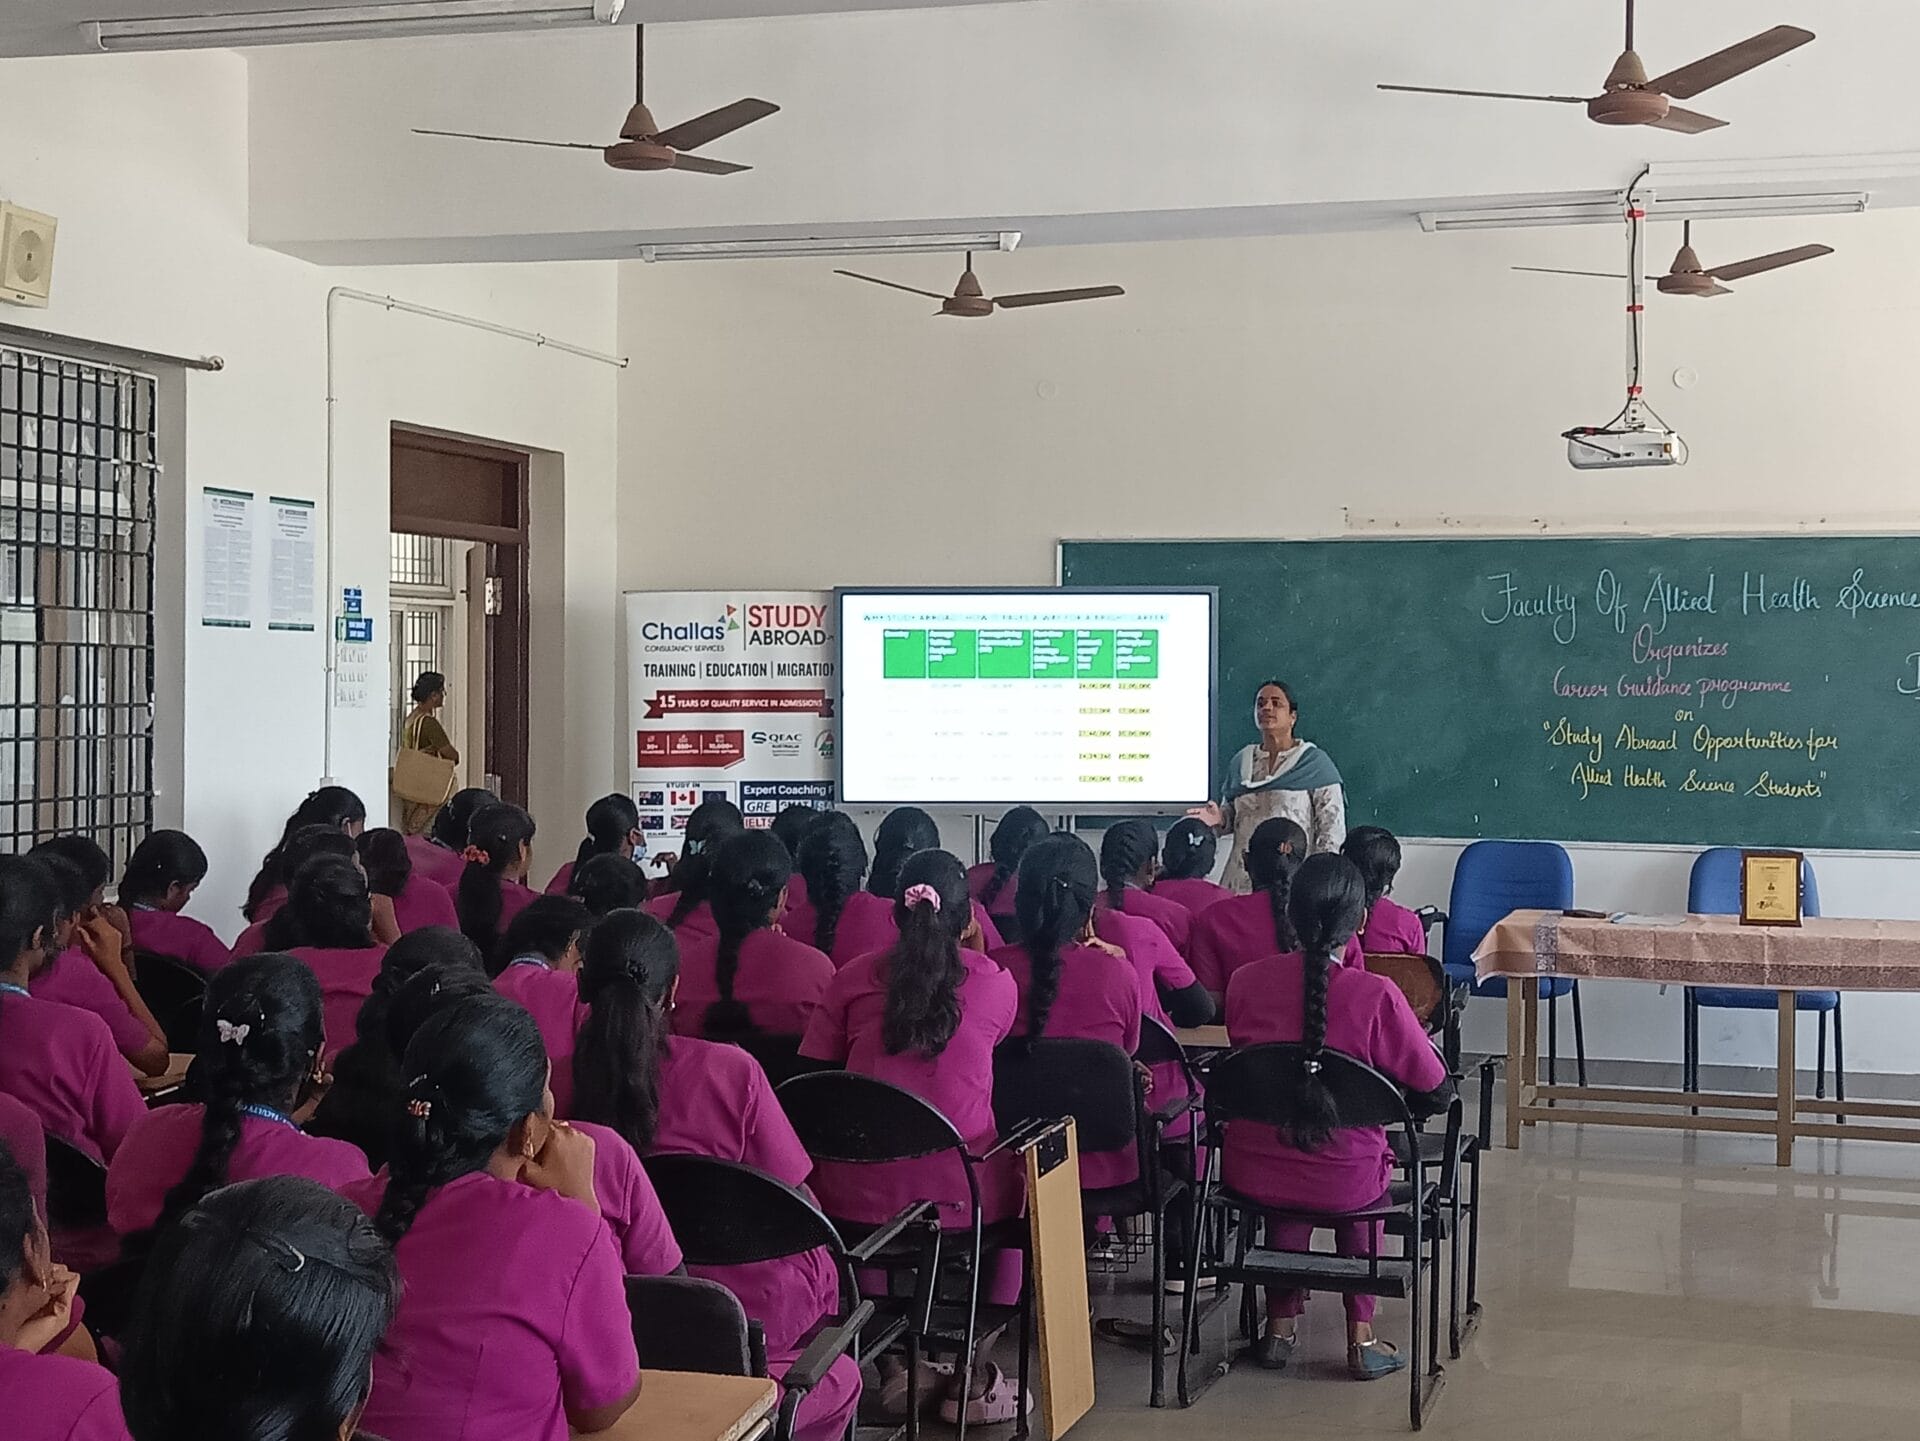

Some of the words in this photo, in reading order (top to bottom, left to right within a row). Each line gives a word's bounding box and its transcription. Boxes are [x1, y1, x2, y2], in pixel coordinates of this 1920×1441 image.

[1481, 572, 1576, 644] Faculty
[1596, 568, 1628, 633] Of
[1643, 572, 1717, 635] Allied
[1743, 571, 1821, 616] Health
[748, 605, 827, 627] STUDY
[642, 622, 725, 640] Challas
[748, 630, 826, 646] ABROAD
[644, 644, 692, 652] CONSULTANCY
[694, 644, 725, 652] SERVICES
[1632, 623, 1729, 679] Organizes
[643, 663, 696, 677] TRAINING
[706, 663, 767, 677] EDUCATION
[1553, 665, 1608, 698] Career
[1617, 674, 1692, 697] Guidance
[1696, 677, 1792, 710] programme
[659, 695, 676, 708] 15
[677, 699, 699, 708] YEARS
[700, 699, 709, 708] OF
[710, 699, 740, 708] QUALITY
[741, 699, 769, 708] SERVICE
[770, 699, 778, 708] IN
[779, 699, 823, 708] ADMISSIONS
[1675, 709, 1694, 722] on
[1693, 724, 1803, 762] Opportunities
[1807, 728, 1838, 761] for
[1571, 762, 1613, 800] Allied
[1624, 764, 1667, 787] Health
[1679, 768, 1735, 793] Science
[743, 785, 776, 797] Expert
[778, 784, 826, 797] Coaching
[746, 801, 771, 812] GRE
